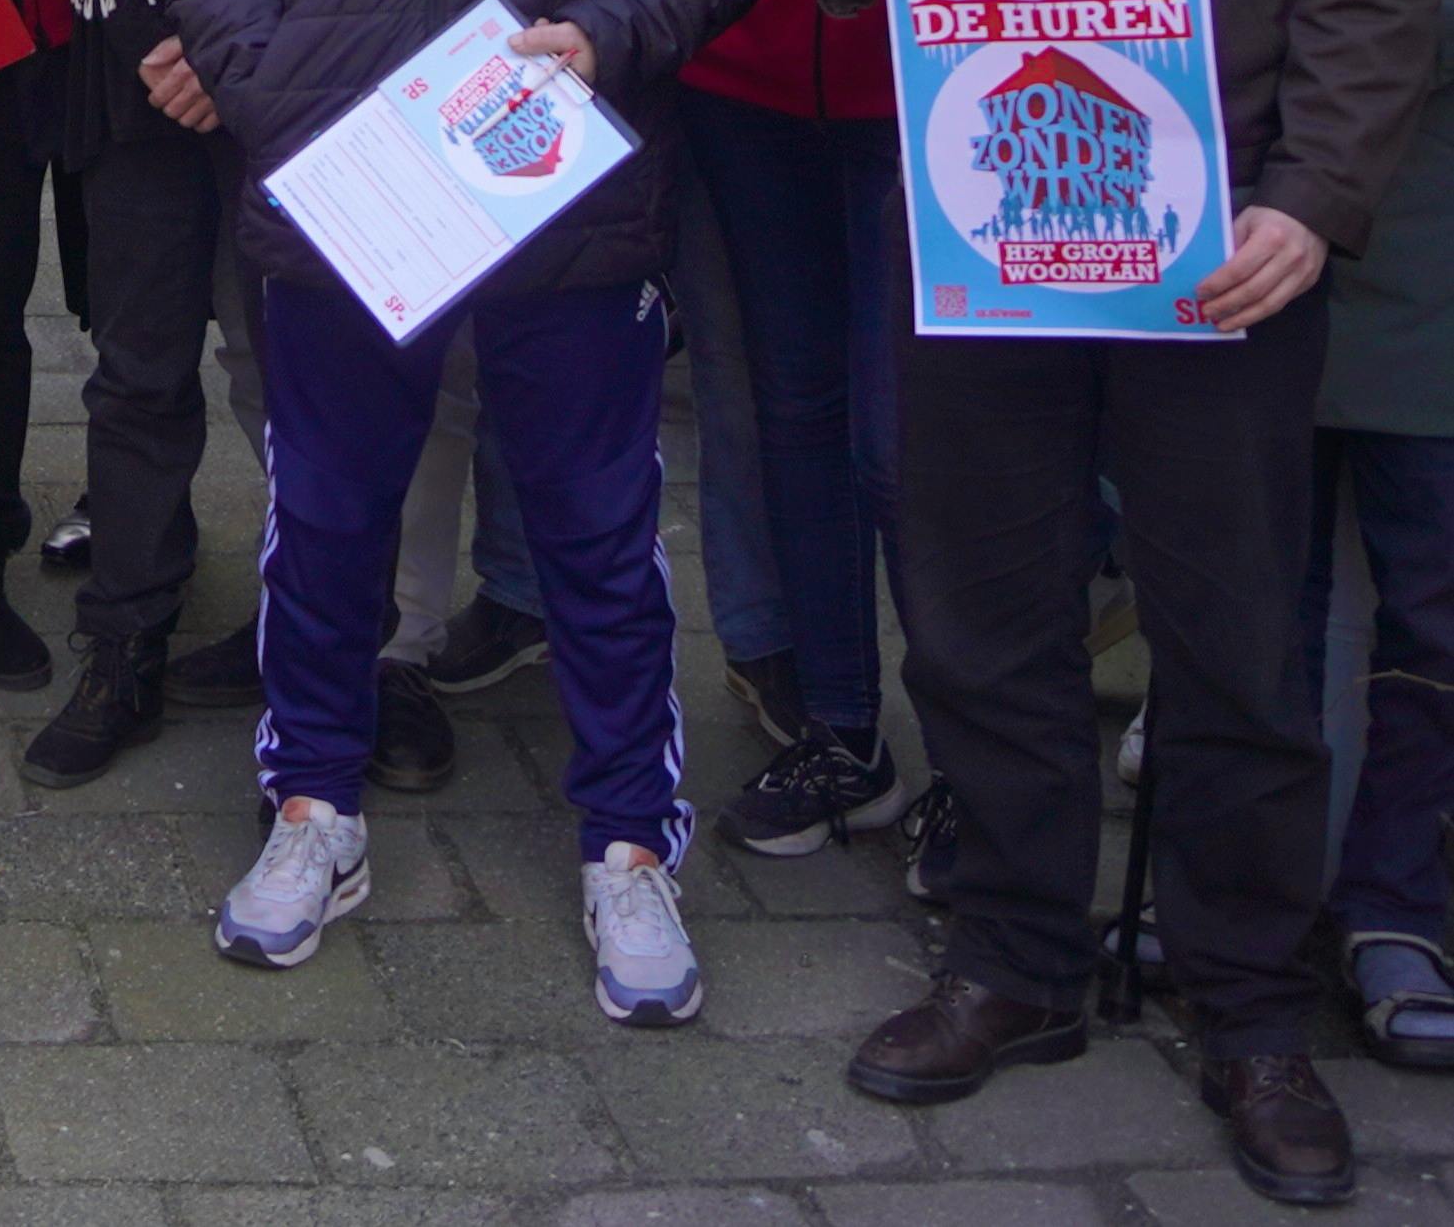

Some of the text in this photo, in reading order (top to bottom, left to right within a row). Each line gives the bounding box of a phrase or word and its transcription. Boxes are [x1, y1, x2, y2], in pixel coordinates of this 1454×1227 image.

[913, 3, 987, 42] DE
[978, 80, 1152, 148] WONEN
[969, 125, 1153, 181] ZONDER
[999, 171, 1147, 210] WINST
[1004, 242, 1153, 262] HET GROTE
[1004, 262, 1156, 282] WOONPLAN
